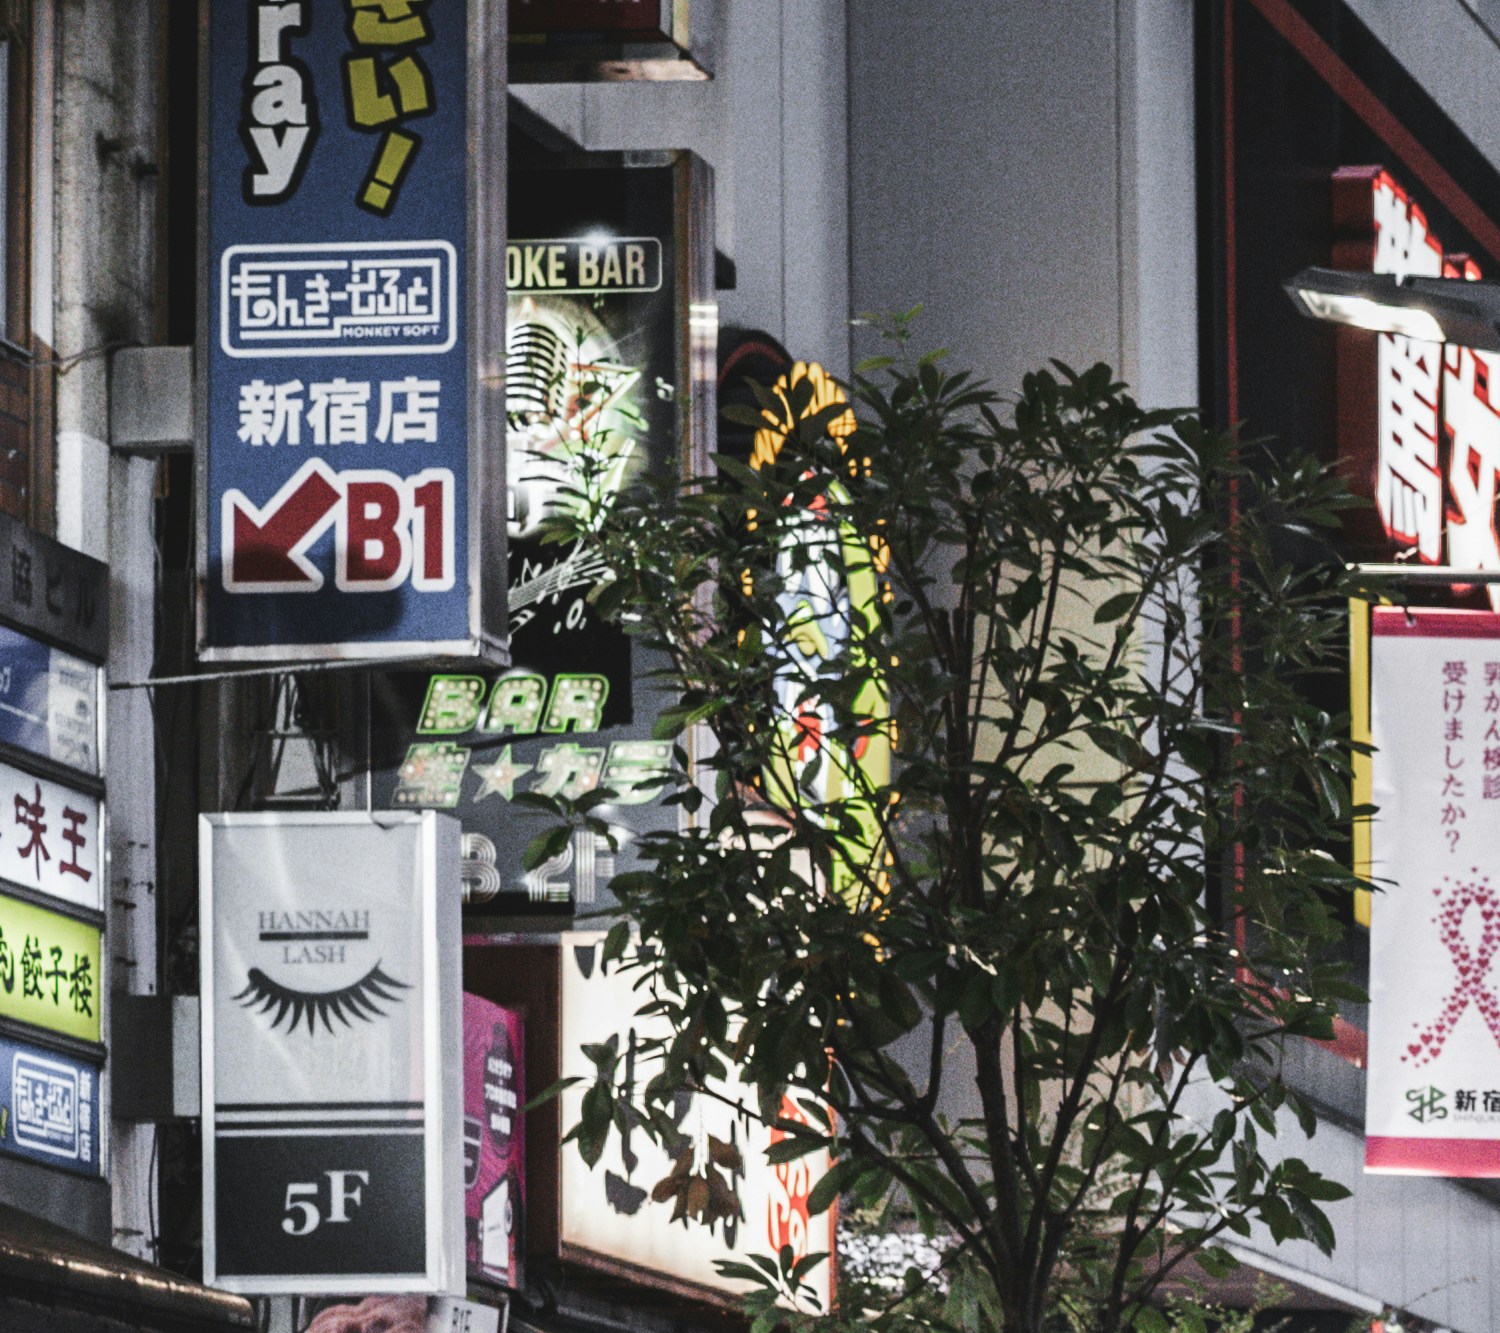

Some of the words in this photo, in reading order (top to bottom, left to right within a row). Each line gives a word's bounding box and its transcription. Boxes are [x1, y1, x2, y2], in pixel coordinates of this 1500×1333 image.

[579, 244, 645, 286] BAR
[231, 268, 429, 327] もんきーそふと
[342, 326, 399, 338] MONKEY
[402, 323, 440, 336] SOFT
[237, 376, 441, 446] 新宿店
[336, 470, 453, 591] B1
[416, 673, 610, 734] BAR
[1441, 660, 1470, 855] 受けましたか?
[14, 782, 92, 882] 味王
[257, 910, 370, 931] HANNAH
[281, 945, 345, 965] LASH
[281, 1170, 369, 1235] 5F
